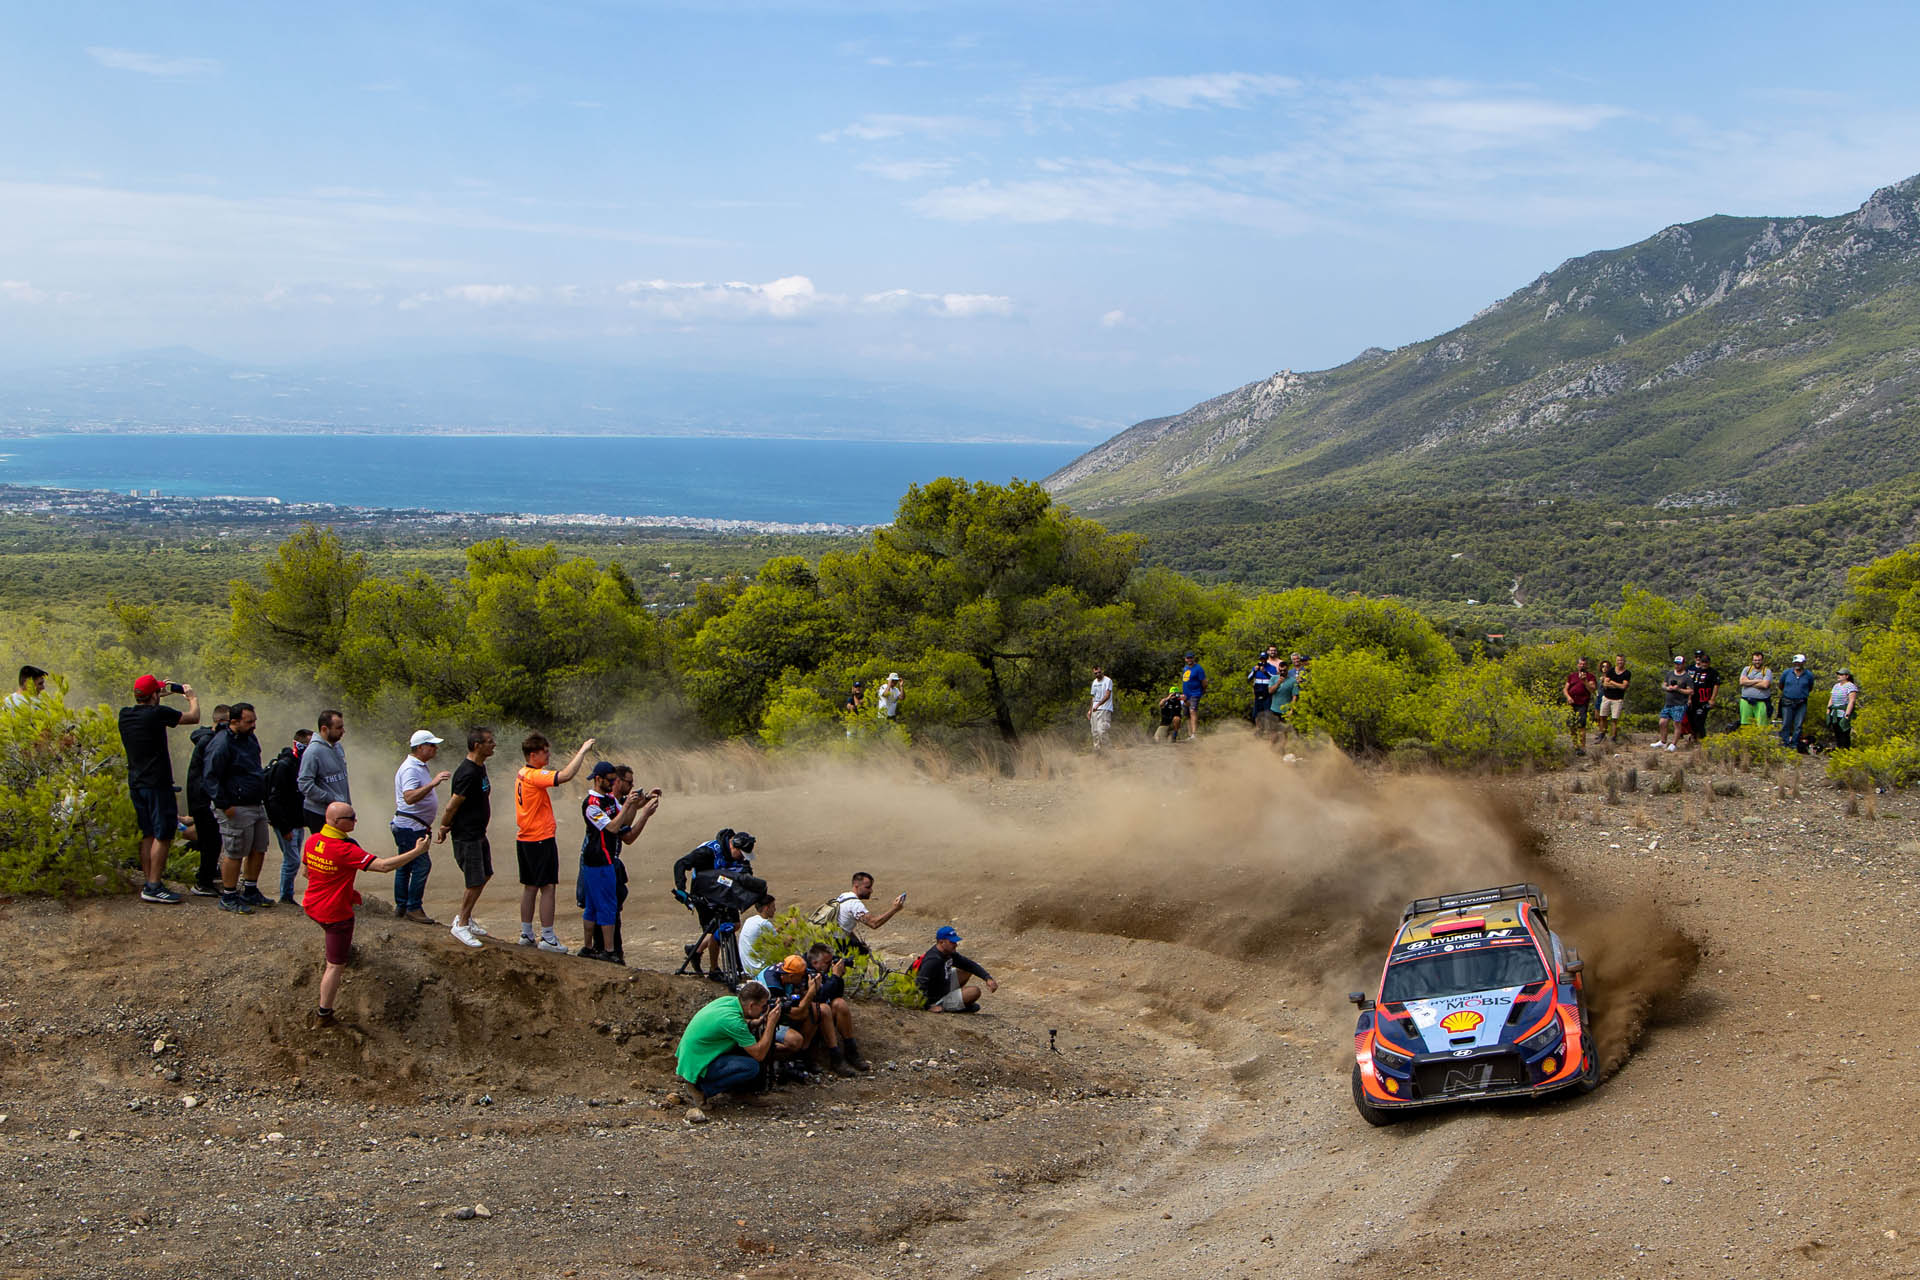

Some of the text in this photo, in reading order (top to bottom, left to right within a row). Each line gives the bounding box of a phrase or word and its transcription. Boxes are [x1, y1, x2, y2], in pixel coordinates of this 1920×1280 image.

[518, 782, 523, 806] 9
[1431, 932, 1482, 946] HYUNDAI
[1455, 942, 1481, 950] WRC
[1430, 995, 1483, 1006] HYUNDAI
[1447, 997, 1511, 1010] MOBIS
